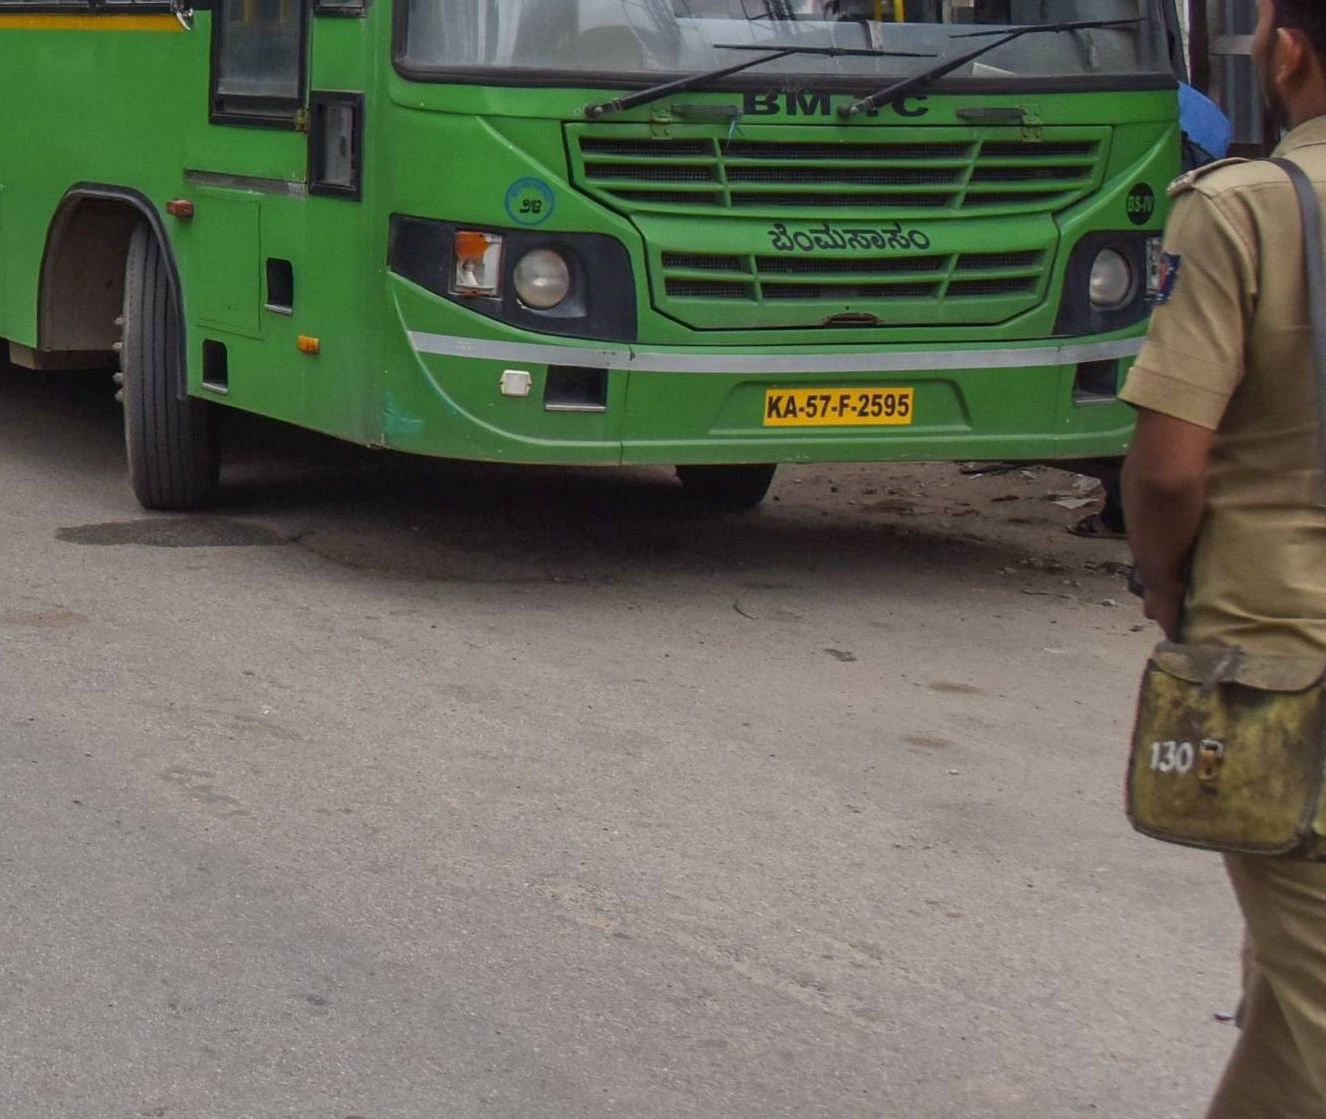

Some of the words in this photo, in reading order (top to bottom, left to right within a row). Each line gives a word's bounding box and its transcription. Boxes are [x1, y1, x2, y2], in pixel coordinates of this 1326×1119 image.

[1128, 195, 1154, 213] BS-IV
[767, 394, 910, 418] KA-57-F-2595
[1150, 740, 1194, 773] 130
